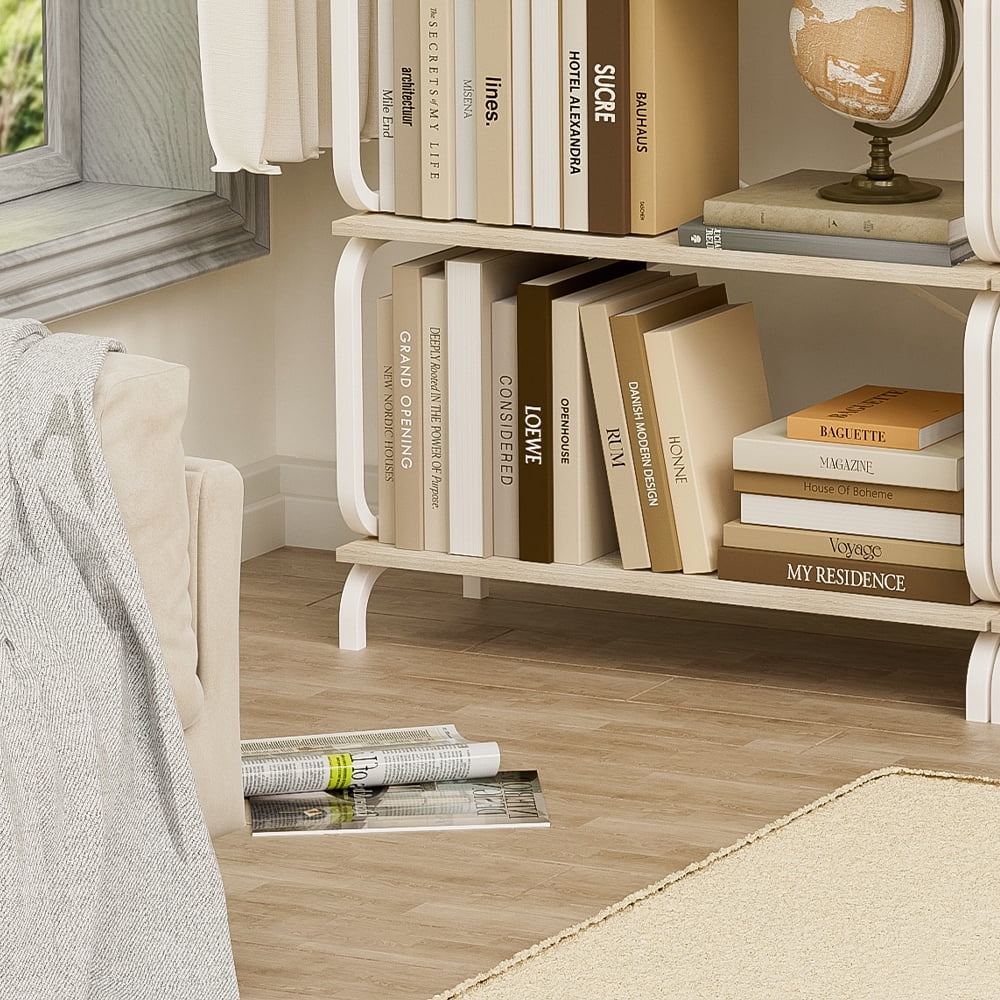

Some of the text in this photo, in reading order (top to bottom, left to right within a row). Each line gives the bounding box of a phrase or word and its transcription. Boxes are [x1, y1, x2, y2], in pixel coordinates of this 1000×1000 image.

[429, 20, 438, 96] SECRETS
[383, 89, 393, 138] Mile End
[401, 66, 415, 127] architectuur
[485, 76, 502, 126] lines.
[569, 51, 581, 174] HOTEL ALEXANDRA
[594, 64, 615, 123] SUCRE
[430, 108, 438, 131] MY
[636, 91, 648, 152] BAUHAUS
[430, 143, 439, 179] LIFE
[399, 331, 412, 469] GRAND OPENING
[829, 390, 907, 419] BAGUETTE
[500, 375, 513, 486] CONSIDERED
[524, 405, 541, 465] LOEWE
[561, 398, 569, 465] OPENHOUSE
[606, 428, 626, 468] RUM
[628, 381, 658, 507] DANISH MODERN DESIGN
[820, 426, 886, 442] BAGUETTE
[668, 435, 687, 484] HONNE
[820, 456, 875, 475] MAGAZINE
[829, 537, 882, 560] Voyage
[787, 564, 905, 592] MY RESIDENCE
